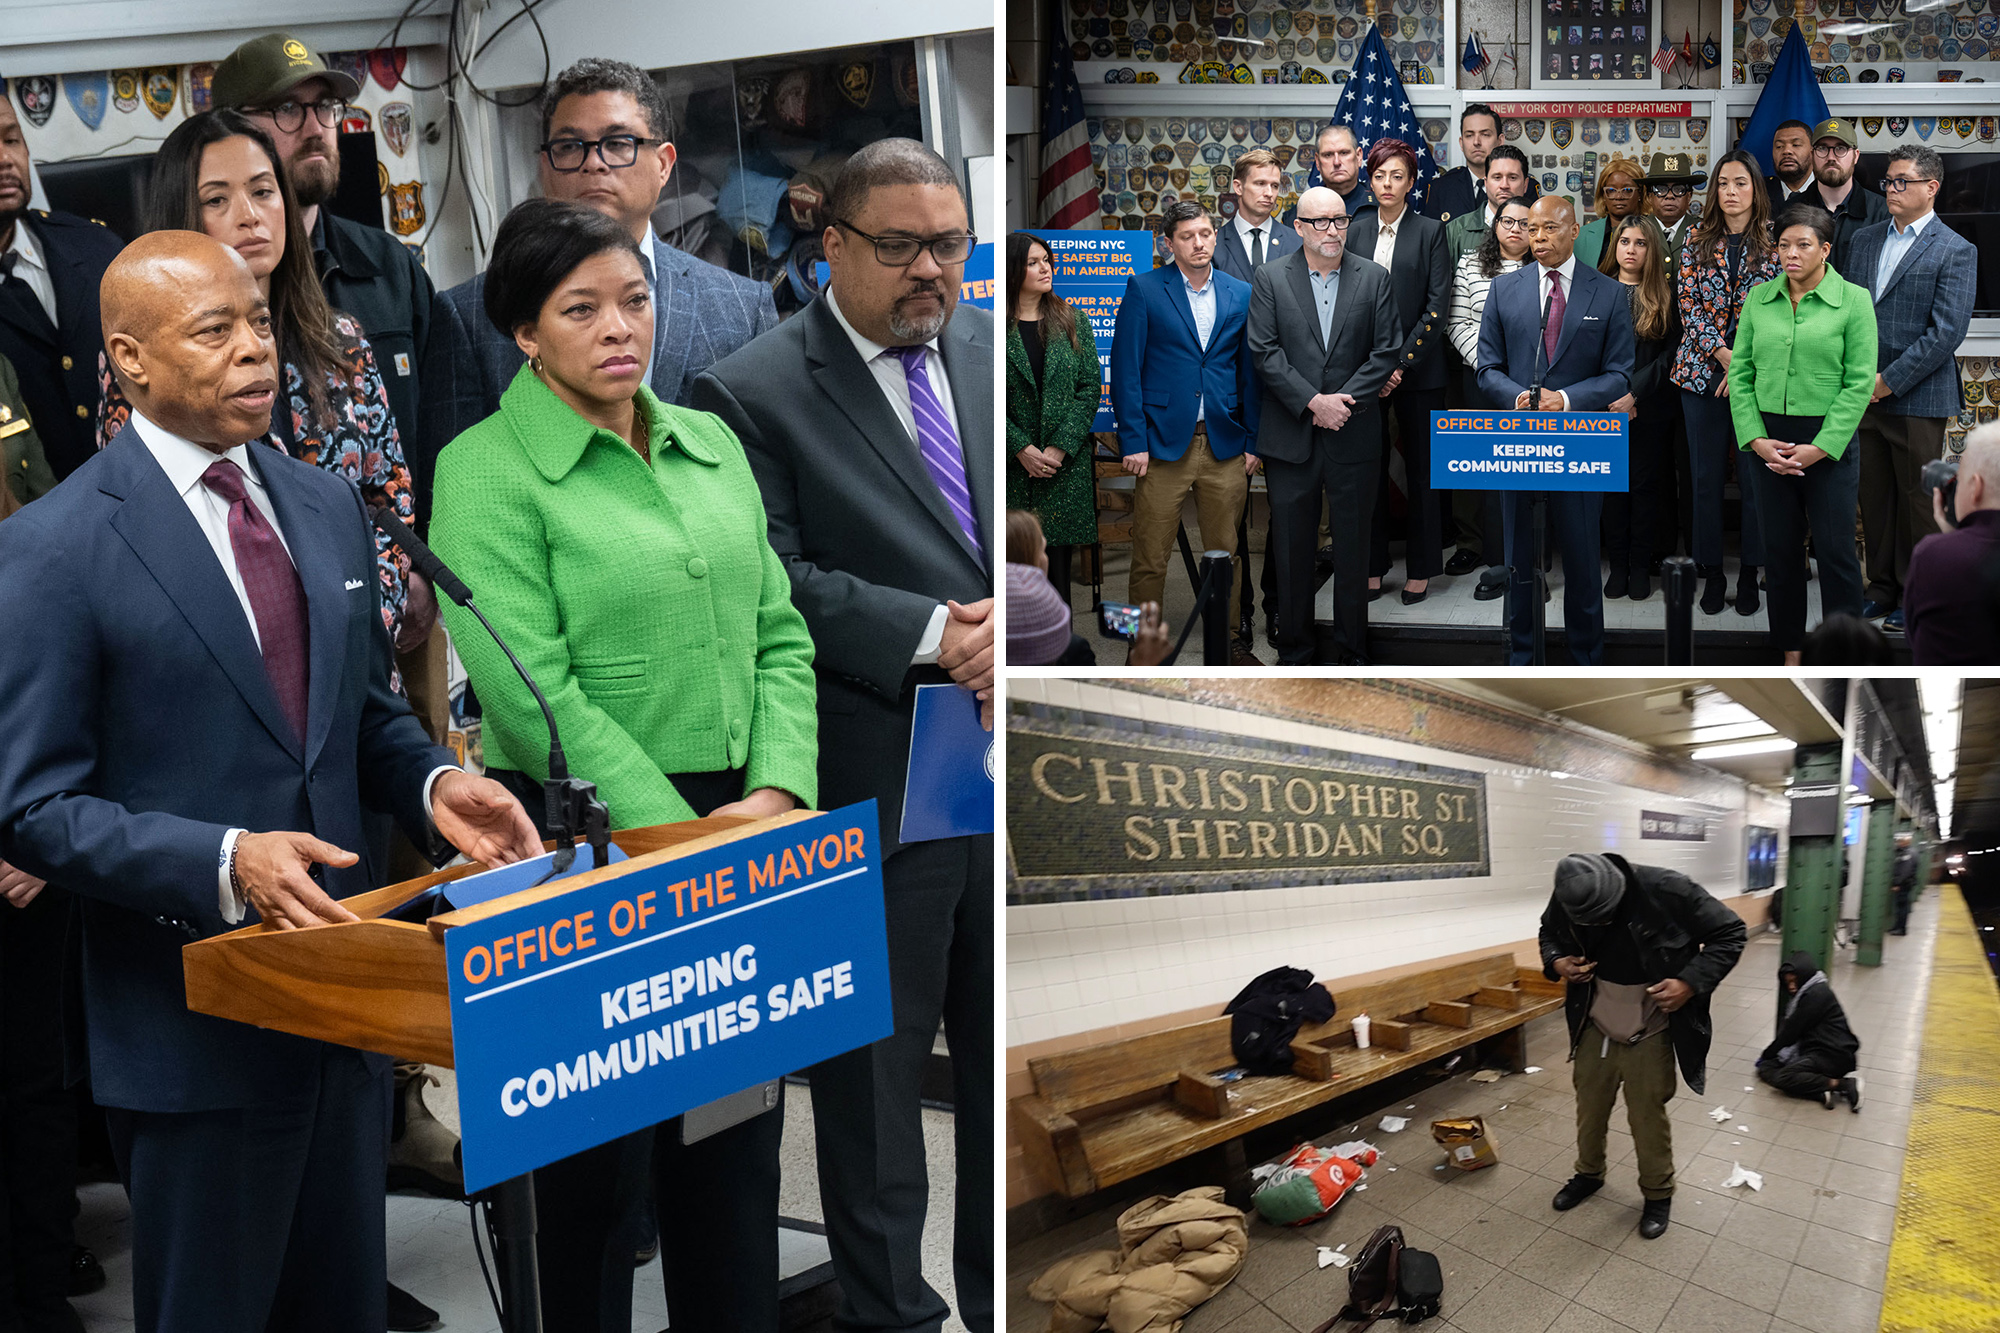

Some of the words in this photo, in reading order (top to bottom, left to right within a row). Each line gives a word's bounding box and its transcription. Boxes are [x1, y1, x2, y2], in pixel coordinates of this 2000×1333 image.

[1204, 63, 1223, 71] POLICE
[1493, 103, 1515, 113] NEW
[1520, 103, 1547, 113] YORK
[1551, 103, 1574, 113] CITY
[1578, 103, 1613, 113] POLICE
[1617, 103, 1683, 113] DEPARTMENT
[1100, 240, 1126, 249] NYC
[1062, 253, 1108, 263] SAFEST
[1111, 253, 1132, 263] BIG
[1063, 267, 1076, 276] IN
[1079, 266, 1136, 276] AMERICA
[1065, 297, 1096, 305] OVER
[1081, 308, 1110, 316] EGAL
[1436, 418, 1493, 430] OFFICE
[1499, 418, 1521, 430] OF
[1526, 419, 1557, 431] THE
[1563, 419, 1621, 432] MAYOR
[1493, 444, 1565, 457] KEEPING
[1447, 460, 1565, 474] COMMUNITIES
[1568, 461, 1611, 474] SAFE
[1030, 752, 1422, 820] CHRISTOPHER
[1436, 793, 1473, 824] ST.
[1124, 816, 1383, 861] SHERIDAN
[463, 911, 596, 985] OFFICE
[608, 890, 657, 937] OF
[668, 866, 737, 918] THE
[748, 827, 865, 894] MAYOR
[600, 944, 757, 1029] KEEPING
[500, 995, 760, 1118] COMMUNITIES
[768, 961, 854, 1023] SAFE
